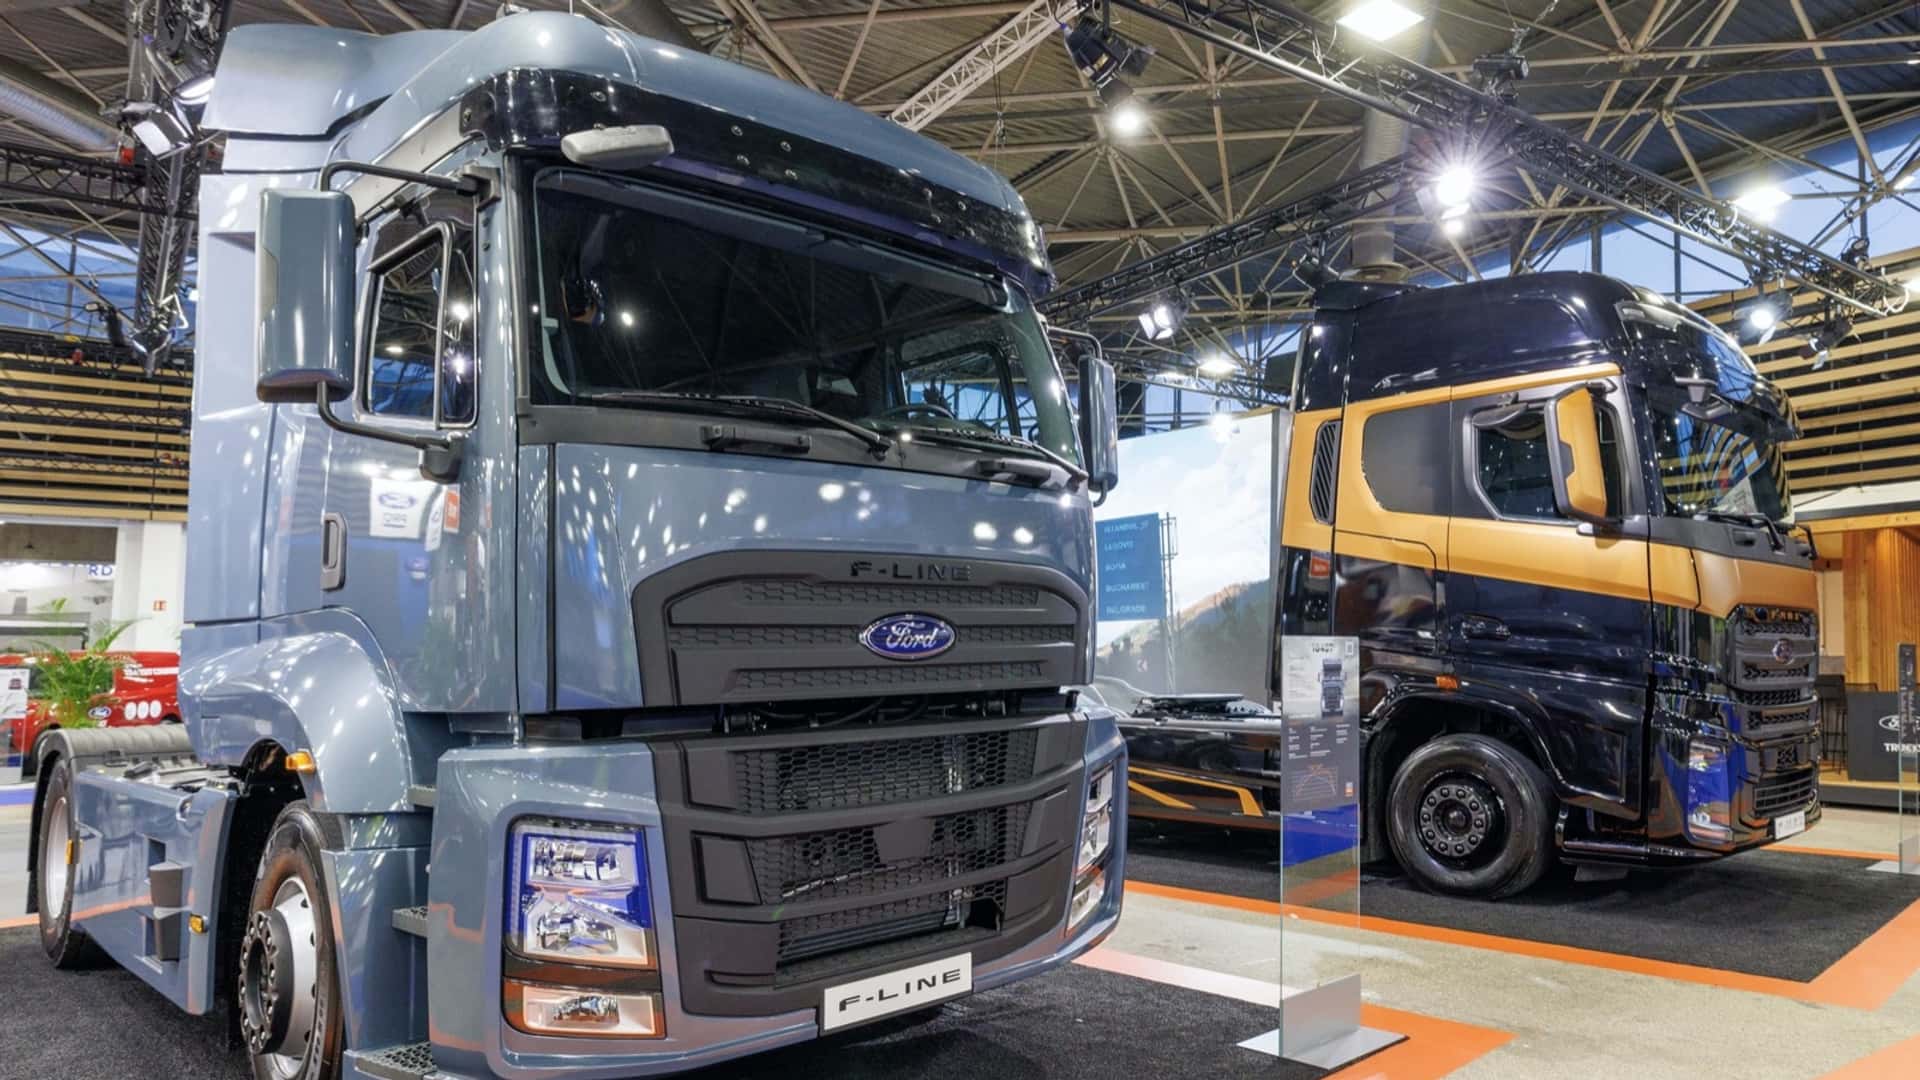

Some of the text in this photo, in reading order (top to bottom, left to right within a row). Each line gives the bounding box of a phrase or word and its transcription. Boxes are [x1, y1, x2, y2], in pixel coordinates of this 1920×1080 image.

[850, 560, 971, 581] F-LINE
[885, 621, 937, 649] Ford
[838, 968, 961, 1012] F-LINE
